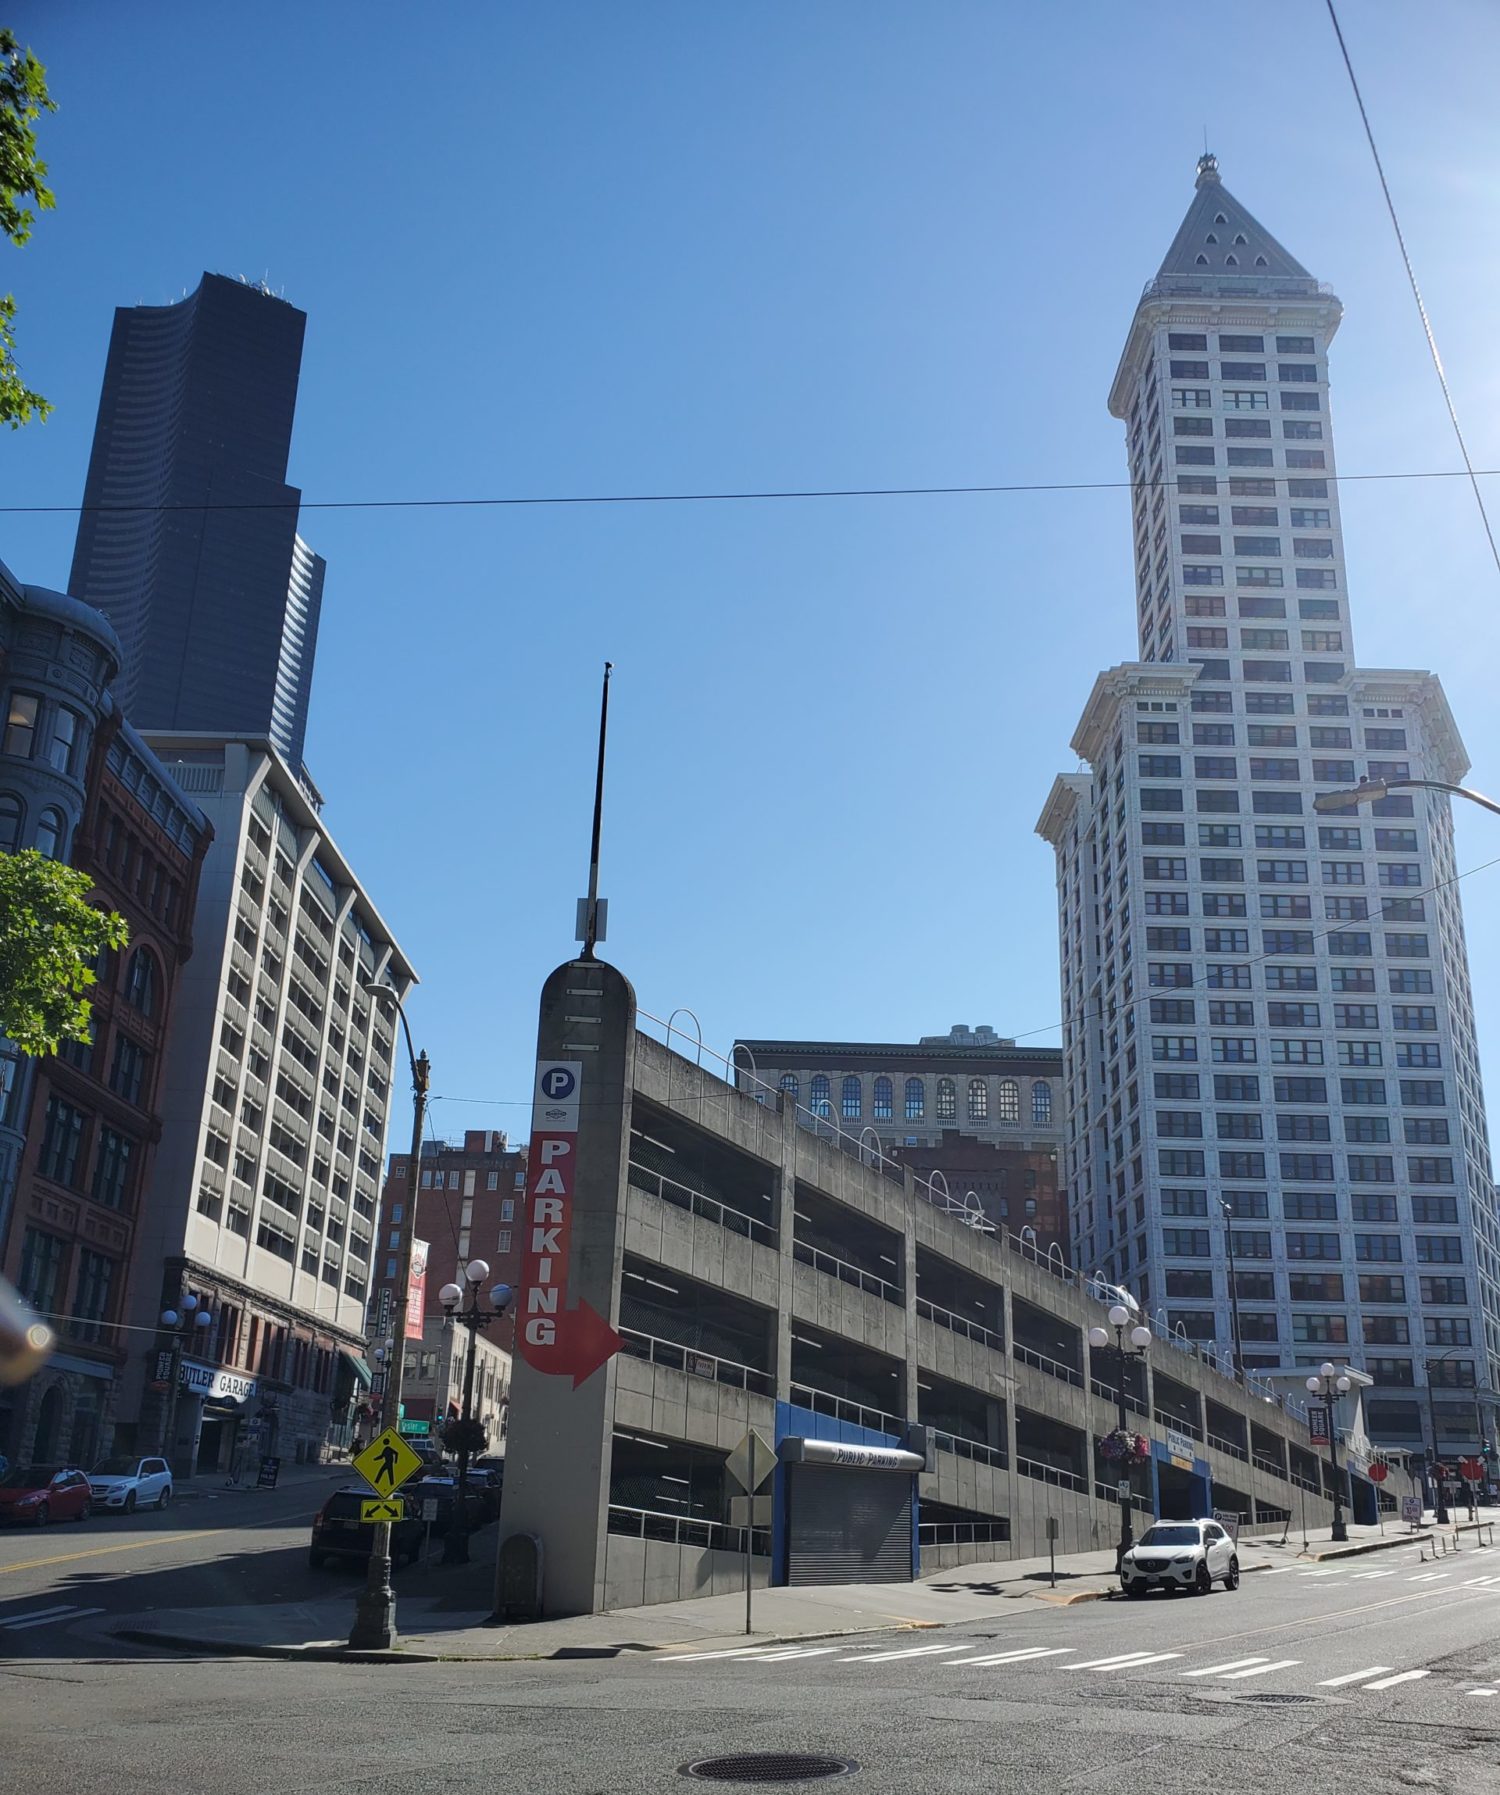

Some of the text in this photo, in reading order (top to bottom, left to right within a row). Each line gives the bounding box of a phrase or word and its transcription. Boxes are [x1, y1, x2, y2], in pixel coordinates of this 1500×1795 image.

[550, 1073, 568, 1095] P
[525, 1139, 571, 1346] PARKING
[179, 1364, 255, 1397] BUTLER GARAGE
[836, 1448, 899, 1468] PUBLIC PARKING
